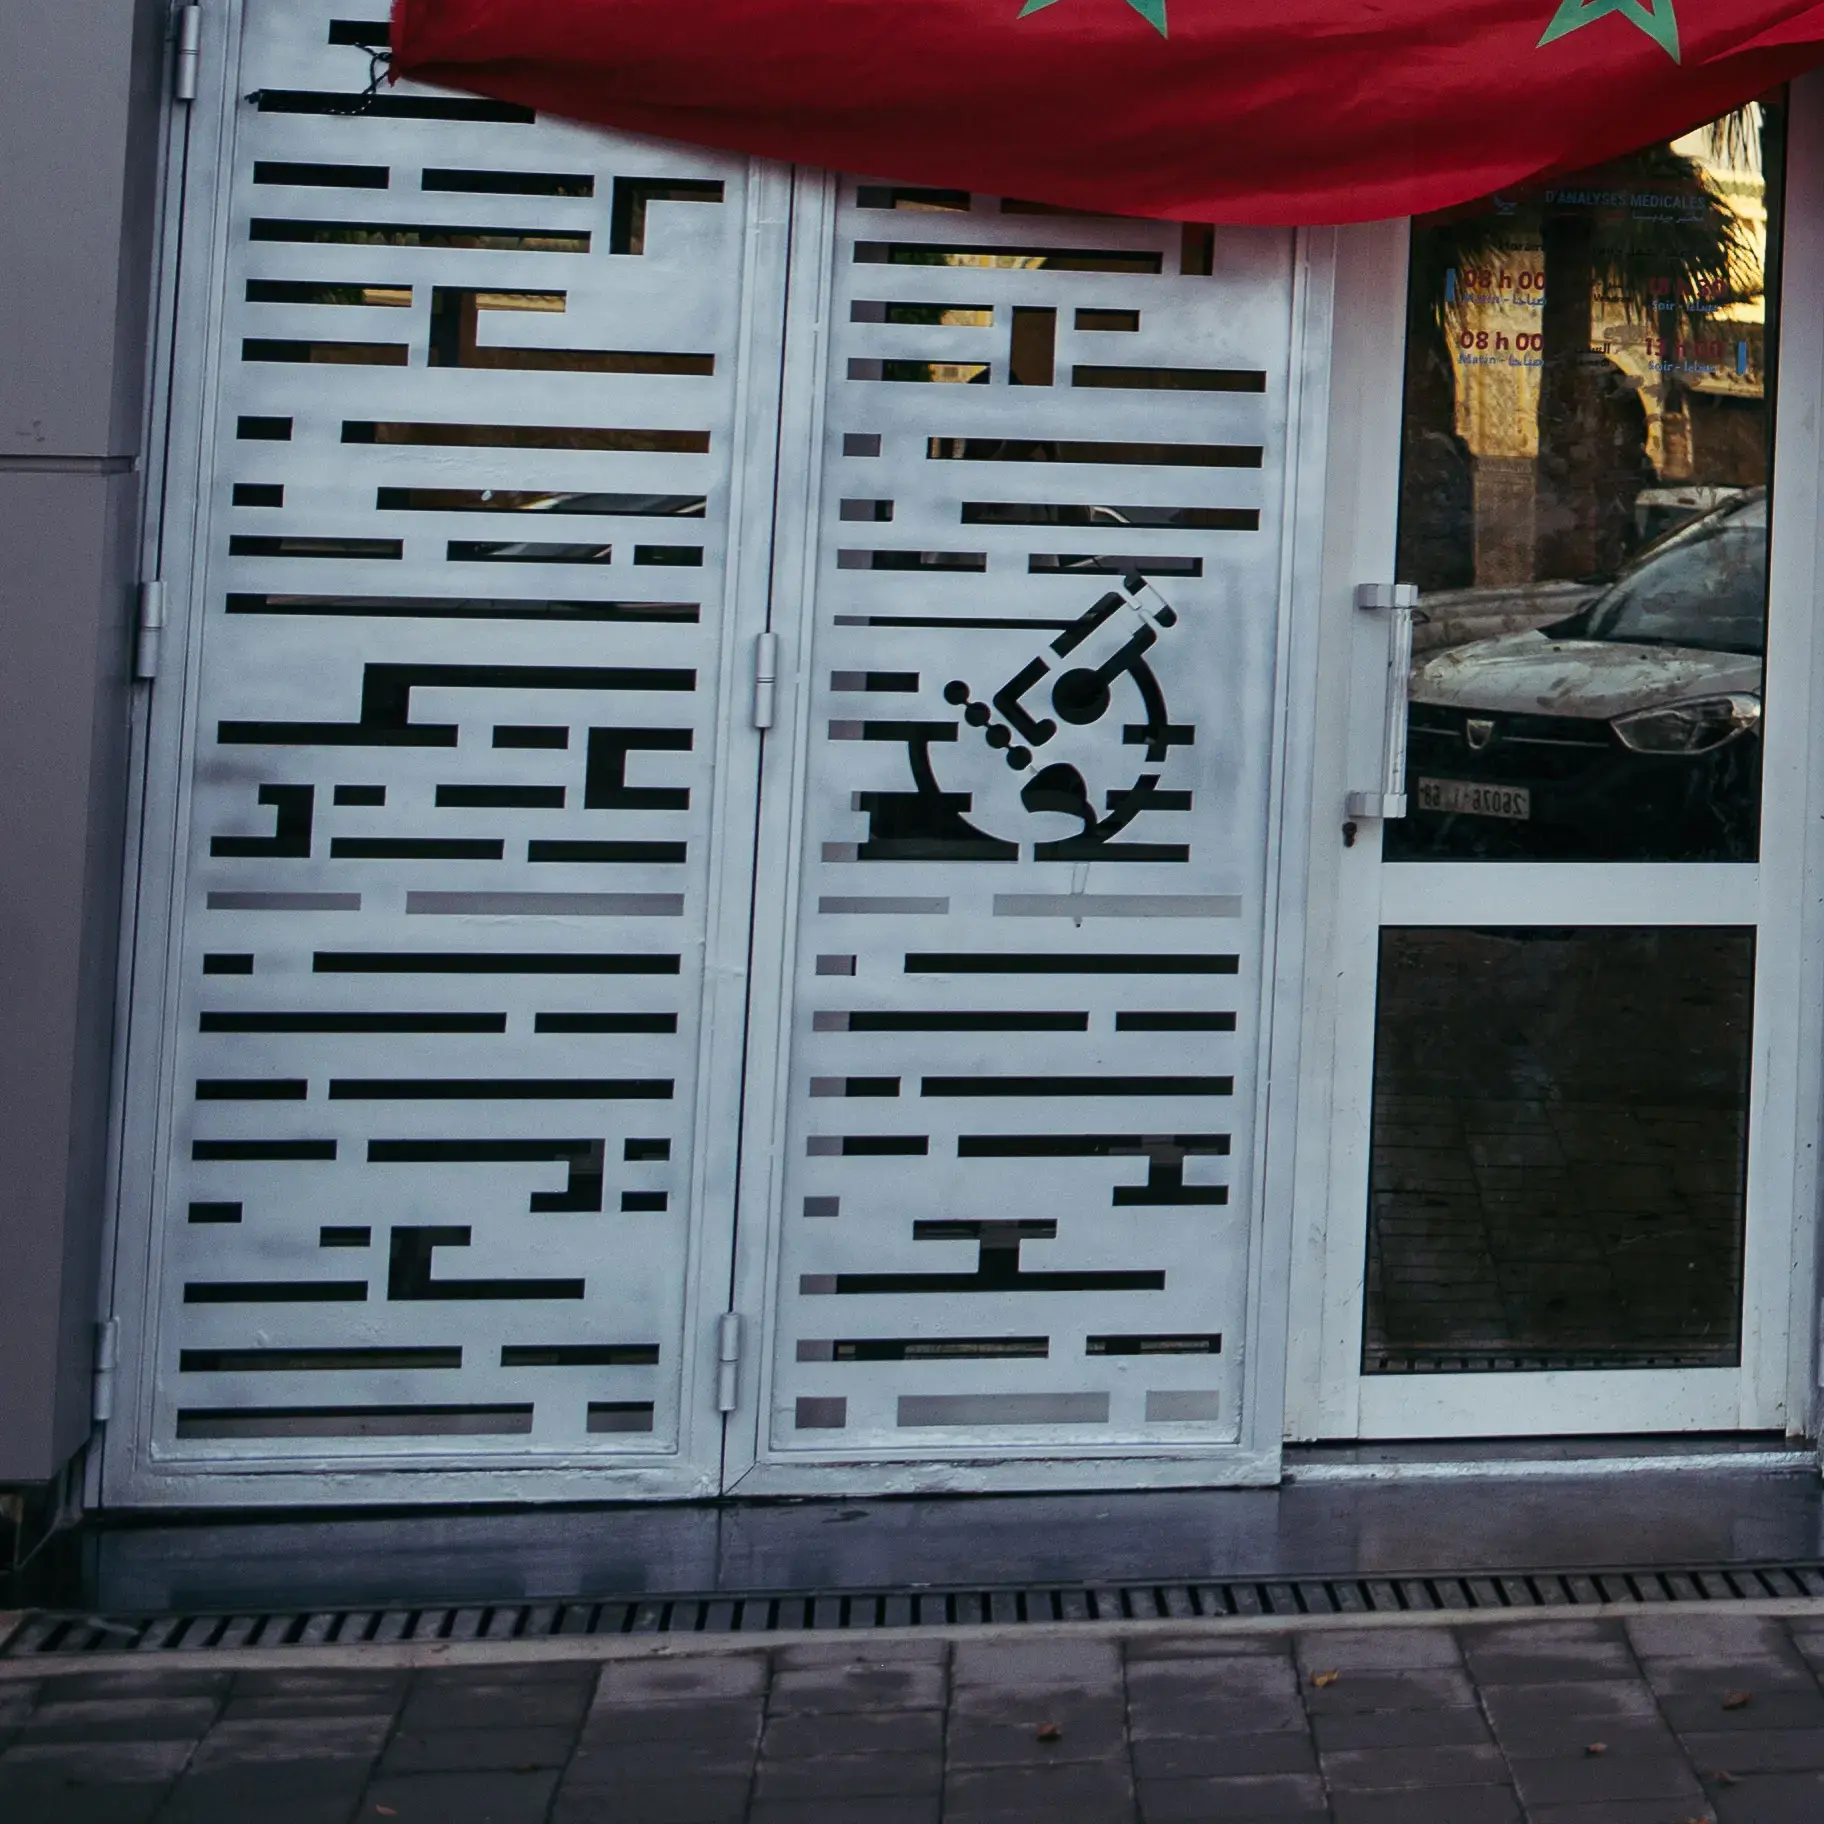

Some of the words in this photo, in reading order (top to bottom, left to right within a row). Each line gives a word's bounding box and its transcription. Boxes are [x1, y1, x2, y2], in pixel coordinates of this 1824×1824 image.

[1463, 268, 1493, 289] 08
[1500, 268, 1512, 289] h
[1519, 271, 1546, 290] 00
[1460, 330, 1489, 350] 08
[1495, 331, 1509, 351] h
[1515, 332, 1544, 352] 00
